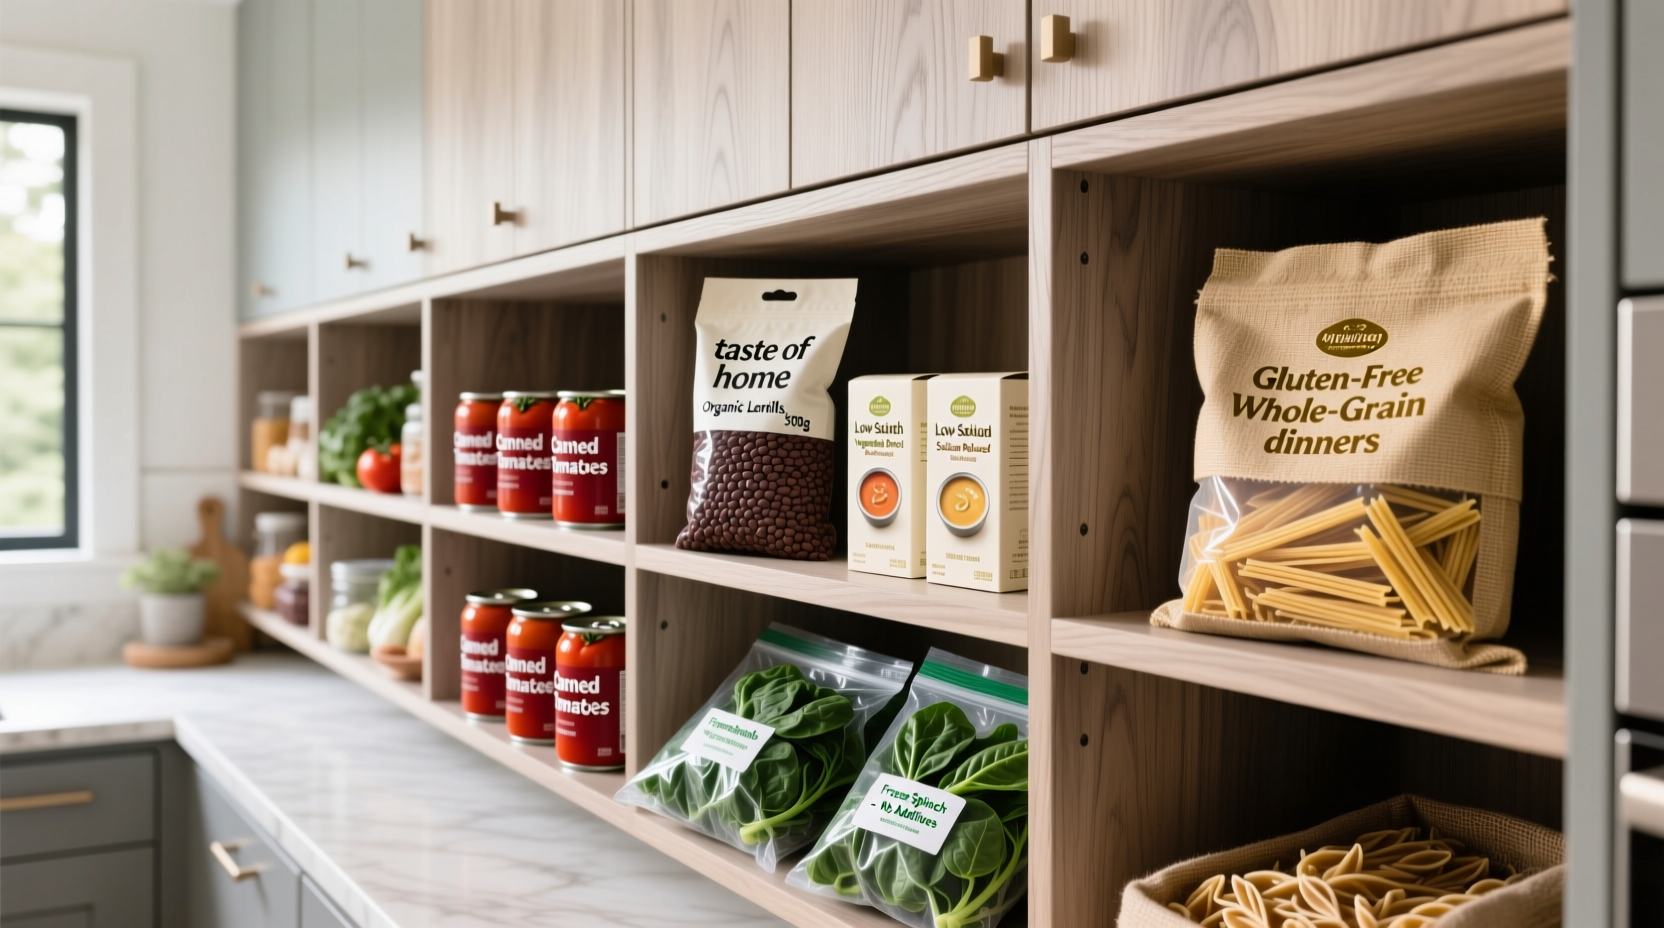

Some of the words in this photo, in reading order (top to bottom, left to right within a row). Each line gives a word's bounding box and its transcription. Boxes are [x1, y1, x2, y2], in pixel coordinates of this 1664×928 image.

[714, 338, 778, 361] taste
[781, 335, 816, 360] of
[712, 363, 791, 390] home
[1252, 364, 1424, 391] Gluten-Free
[702, 400, 744, 417] Organic
[1232, 391, 1426, 423] Whole-Grain
[1263, 428, 1380, 455] dinners
